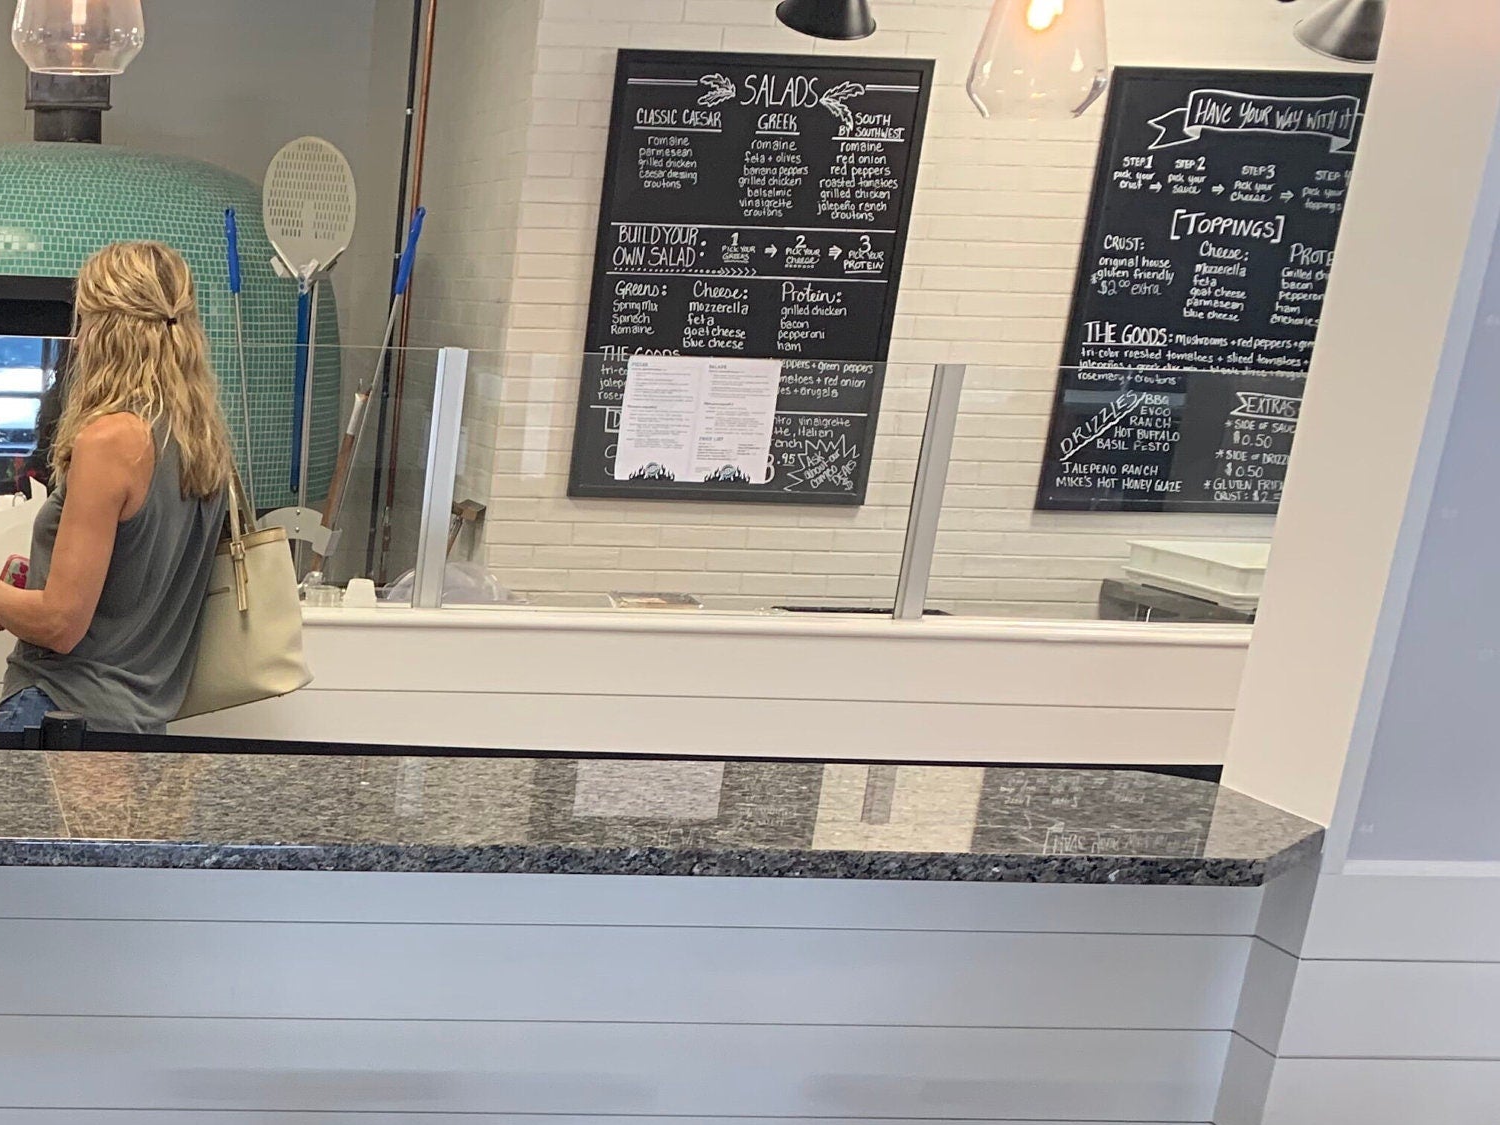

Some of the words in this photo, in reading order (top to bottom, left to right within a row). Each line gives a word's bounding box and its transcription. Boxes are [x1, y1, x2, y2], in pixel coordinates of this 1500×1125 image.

[740, 74, 819, 108] SALADS
[636, 108, 678, 125] CLASSIC
[682, 109, 722, 128] CAESAR
[757, 113, 798, 132] GREEK
[854, 112, 891, 126] SOUTH
[1239, 100, 1273, 129] YOUR
[1276, 105, 1304, 132] WAY
[1306, 109, 1338, 132] WITH
[838, 125, 851, 138] BY
[854, 127, 906, 139] SOUTHWEST
[648, 135, 690, 146] romaine
[751, 138, 798, 151] romaine
[840, 141, 884, 153] romaine
[638, 157, 663, 169] grilled
[665, 158, 697, 169] chicken
[744, 150, 765, 164] feta
[776, 152, 802, 164] olives
[836, 153, 855, 165] red
[858, 155, 887, 165] onion
[1122, 155, 1146, 168] STEP
[1144, 154, 1154, 169] 1
[1174, 158, 1195, 169] STEP
[1196, 156, 1206, 171] 2
[743, 165, 777, 176] banana
[779, 166, 809, 177] peppers
[830, 163, 847, 176] red
[851, 166, 891, 179] peppers
[1113, 169, 1132, 181] pick
[1136, 171, 1156, 181] your
[1241, 165, 1267, 177] STEP
[1265, 164, 1276, 180] 3
[1314, 170, 1341, 181] STEP
[643, 179, 682, 189] croutons
[738, 176, 766, 188] grilled
[767, 176, 802, 186] chicken
[819, 177, 855, 188] roasted
[857, 178, 899, 190] tomatoes
[1167, 173, 1185, 184] pick
[1188, 175, 1207, 185] your
[820, 188, 851, 202] grilled
[854, 189, 891, 200] chicken
[1255, 182, 1276, 194] your
[739, 198, 793, 209] vinaigrette
[858, 201, 887, 212] ranch
[743, 208, 783, 217] croutons
[830, 211, 875, 222] croutons
[618, 226, 661, 244] BUILD
[662, 226, 699, 246] YOUR
[730, 232, 739, 246] 1
[795, 234, 807, 249] 2
[1103, 234, 1145, 252] CRUST:
[858, 234, 871, 254] 3
[612, 246, 646, 266] OWN
[785, 247, 803, 256] PICK
[804, 247, 821, 257] YOUR
[848, 250, 865, 260] PICK
[867, 251, 884, 261] YOUR
[843, 259, 884, 271] PROTEIN
[1099, 255, 1139, 271] original
[1142, 256, 1171, 269] house
[1133, 268, 1175, 286] friendly
[1281, 266, 1313, 280] Grilled
[1192, 273, 1218, 288] feta
[1281, 279, 1314, 291] bacon
[693, 280, 749, 300] Cheese:
[781, 281, 842, 304] Protein:
[1131, 282, 1162, 296] extra
[1189, 286, 1212, 301] goat
[1214, 287, 1247, 300] cheese
[781, 305, 809, 320] grilled
[811, 305, 847, 317] chicken
[1183, 307, 1204, 319] blue
[1207, 309, 1240, 322] cheese
[1275, 301, 1301, 315] ham
[687, 313, 715, 326] feta
[780, 319, 809, 329] bacon
[611, 324, 655, 335] Romaine
[684, 325, 710, 340] goat
[711, 326, 746, 339] cheese
[777, 329, 825, 341] pepperoni
[1084, 320, 1117, 344] THE
[1237, 336, 1254, 348] red
[1253, 338, 1292, 350] peppers
[682, 337, 705, 349] blue
[708, 338, 744, 350] cheese
[776, 340, 802, 352] ham
[600, 345, 629, 362] THE
[1124, 348, 1162, 360] roasted
[1166, 350, 1214, 362] tomatoes
[1226, 351, 1254, 364] sliced
[1256, 353, 1302, 367] tomatoes
[818, 361, 840, 374] green
[843, 363, 874, 374] peppers
[824, 375, 838, 386] red
[840, 377, 866, 389] onion
[1078, 372, 1125, 386] rosemary
[1134, 373, 1177, 386] croutons
[1144, 393, 1170, 406] BBQ
[1140, 406, 1172, 417] EVOO
[1246, 396, 1296, 418] EXTRAS
[798, 416, 851, 428] vinaigrette
[1060, 389, 1138, 455] DRIZZLES
[1129, 415, 1172, 429] RANCH
[1234, 418, 1256, 431] SIDE
[1113, 426, 1134, 438] HOT
[1136, 428, 1181, 442] BUFFALO
[1096, 438, 1129, 451] BASIL
[1133, 440, 1170, 452] PESTO
[1225, 449, 1249, 461] SIDE
[1061, 461, 1117, 475] JALEPENO
[1121, 464, 1159, 476] RANCH
[1055, 475, 1093, 488] MIKE'S
[1096, 476, 1119, 489] HOT
[1122, 478, 1153, 493] HONEY
[1154, 479, 1183, 493] GLAZE
[1212, 477, 1252, 490] GLUTEN
